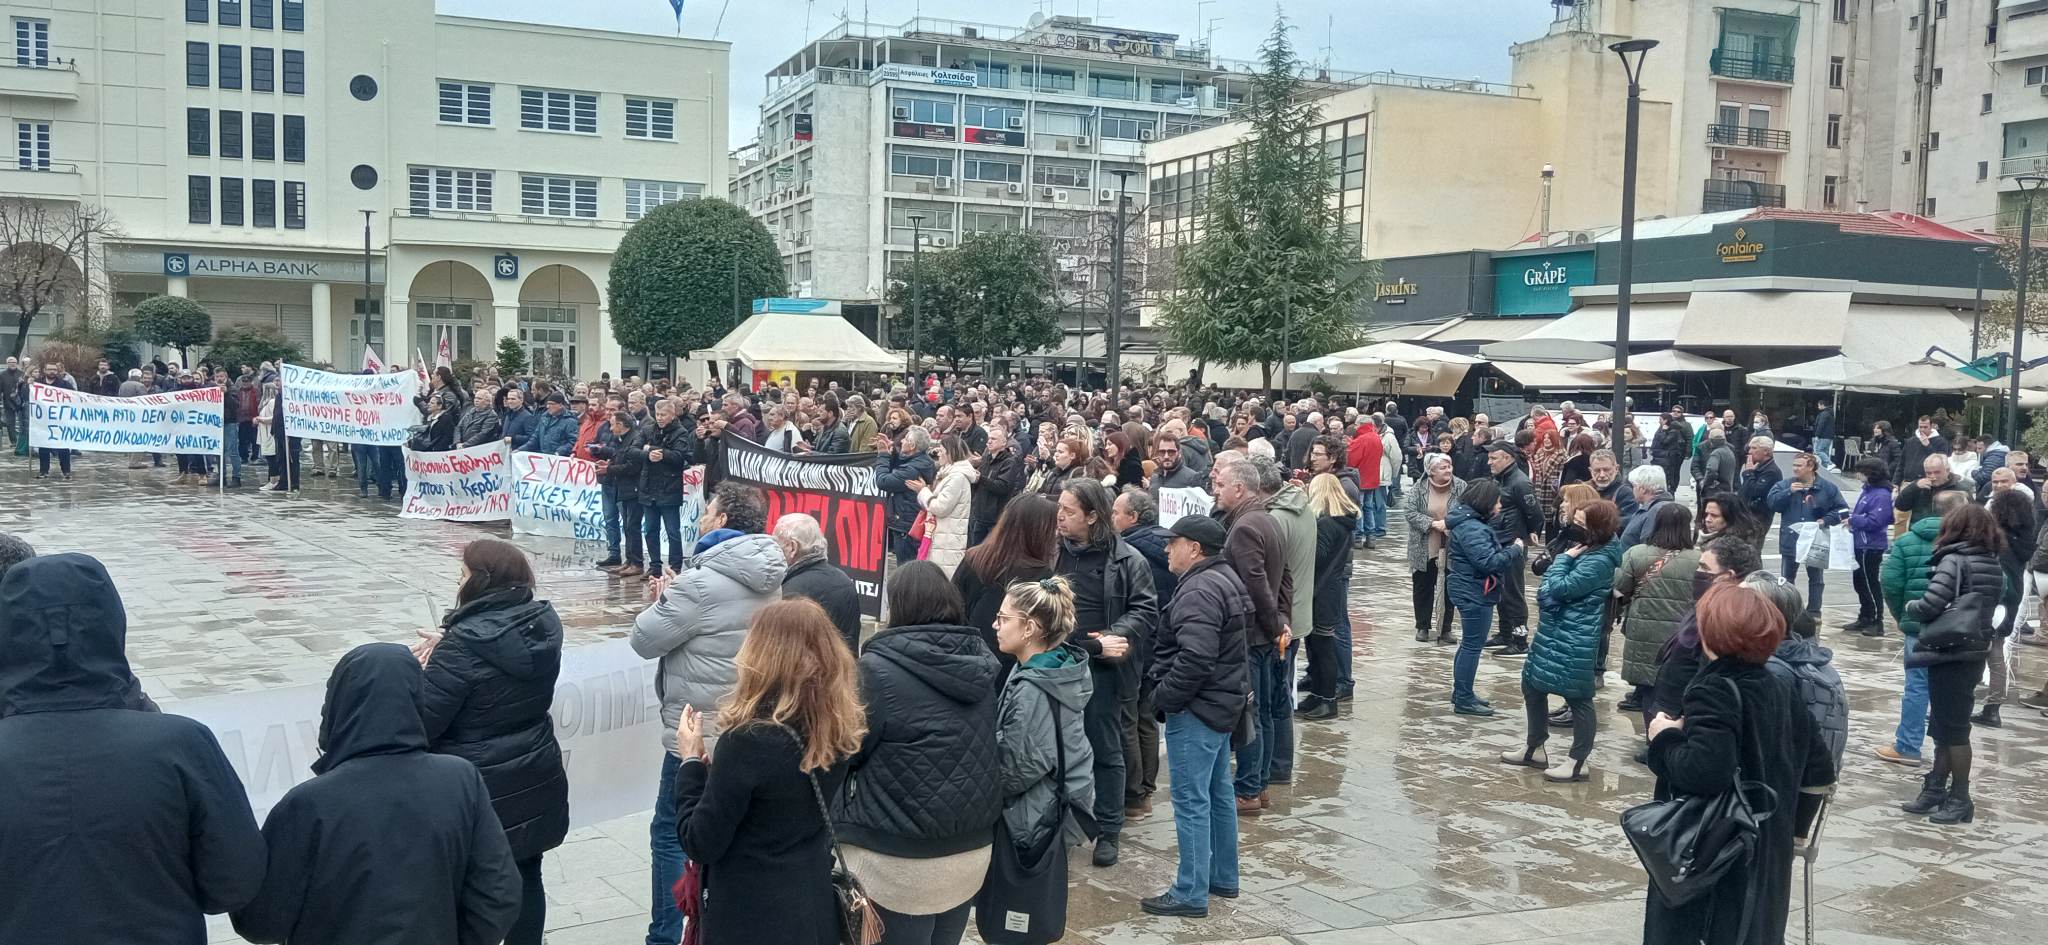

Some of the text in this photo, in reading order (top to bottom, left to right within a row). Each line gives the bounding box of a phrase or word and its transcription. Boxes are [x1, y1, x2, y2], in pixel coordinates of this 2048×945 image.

[931, 70, 976, 83] Κολτσίδας
[195, 259, 320, 276] ALPHA BANK
[1524, 266, 1567, 286] GRAPE
[1373, 282, 1417, 301] JASMINE
[48, 405, 109, 423] ΕΓΚΛΗΜΑ
[112, 407, 136, 423] ΑΥΤΟ
[141, 408, 167, 424] ΔΕΝ
[304, 404, 352, 422] ΓΙΝΟΥΜΕ
[113, 428, 171, 447] ΟΙΚΟΔΟΜΩΝ
[522, 455, 598, 487] ΣΥΓΧΡΟ
